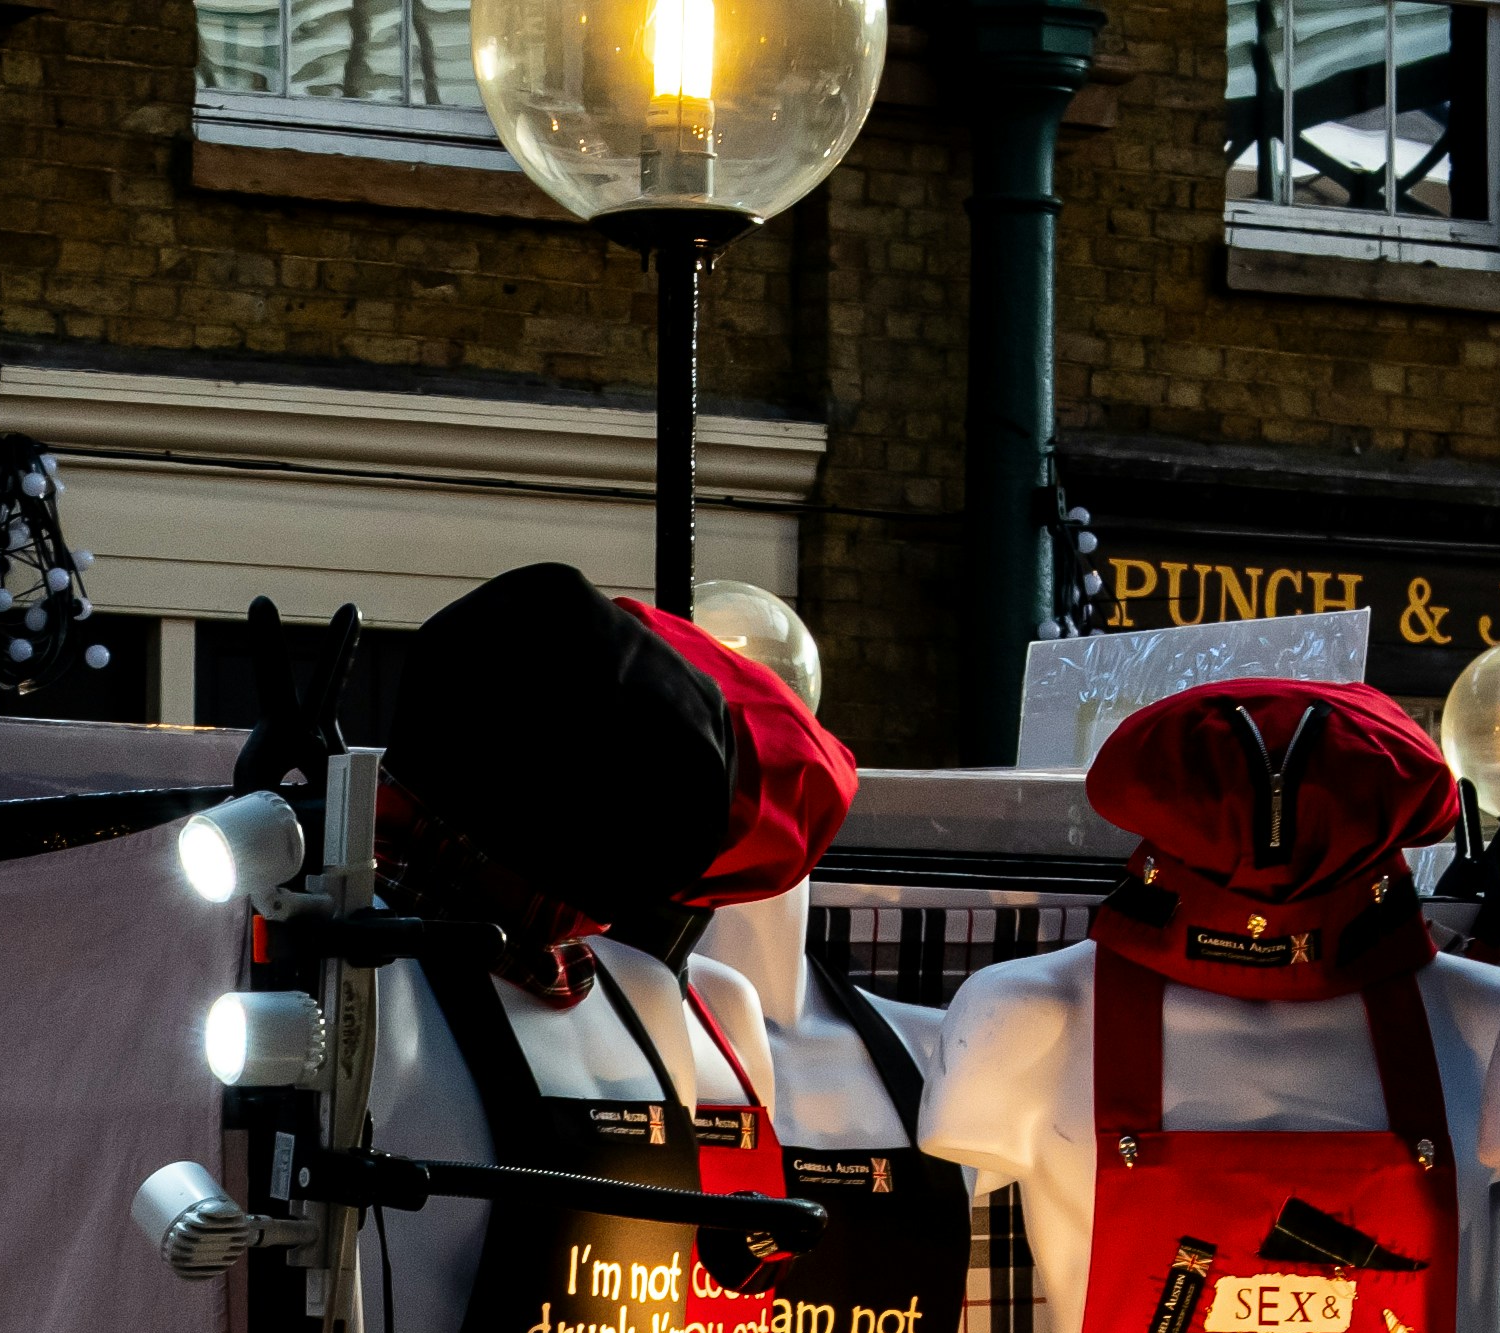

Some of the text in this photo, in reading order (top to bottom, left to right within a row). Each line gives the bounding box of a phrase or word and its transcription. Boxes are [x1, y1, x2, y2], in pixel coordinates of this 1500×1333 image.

[1106, 557, 1364, 628] PUNCH
[1400, 577, 1452, 647] &
[567, 1244, 621, 1300] I'm
[631, 1252, 682, 1303] not
[1234, 1286, 1341, 1327] SEX &
